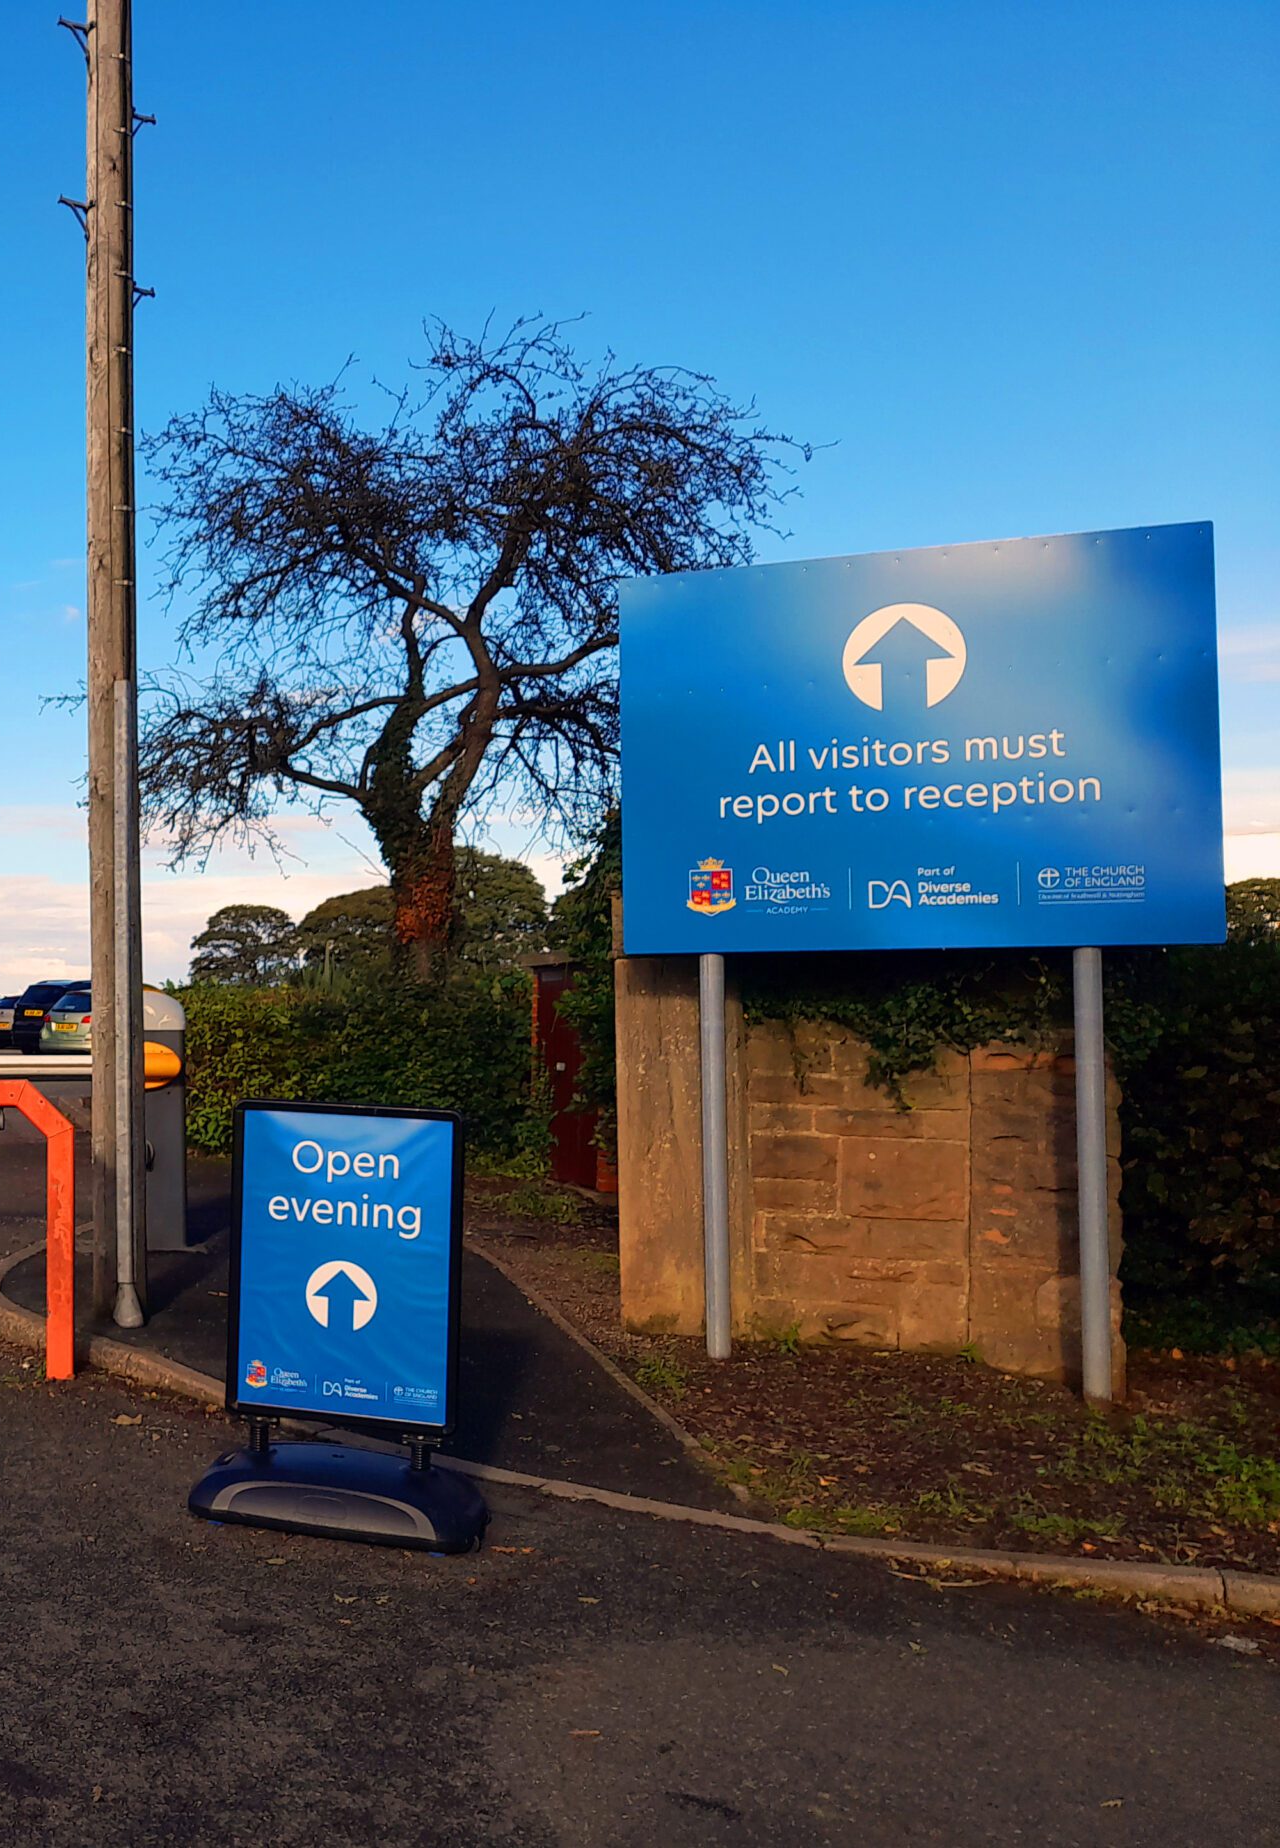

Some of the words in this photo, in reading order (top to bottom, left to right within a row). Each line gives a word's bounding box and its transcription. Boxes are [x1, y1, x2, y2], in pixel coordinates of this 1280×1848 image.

[748, 740, 796, 775] All
[808, 737, 951, 771] visitors
[964, 728, 1066, 762] must
[719, 786, 838, 825] report
[848, 784, 890, 813] to
[903, 771, 1102, 814] reception
[751, 866, 811, 888] Queen
[917, 867, 940, 877] Part
[943, 865, 956, 876] of
[1064, 866, 1089, 877] THE
[1091, 864, 1145, 876] CHURCH
[917, 880, 971, 894] Diverse
[1064, 877, 1081, 888] OF
[1084, 875, 1145, 887] ENGLAND
[744, 883, 831, 904] Elizabeth's
[918, 892, 999, 906] Academies
[766, 906, 809, 914] ACADEMY
[292, 1140, 399, 1183] Open
[268, 1193, 421, 1240] evening
